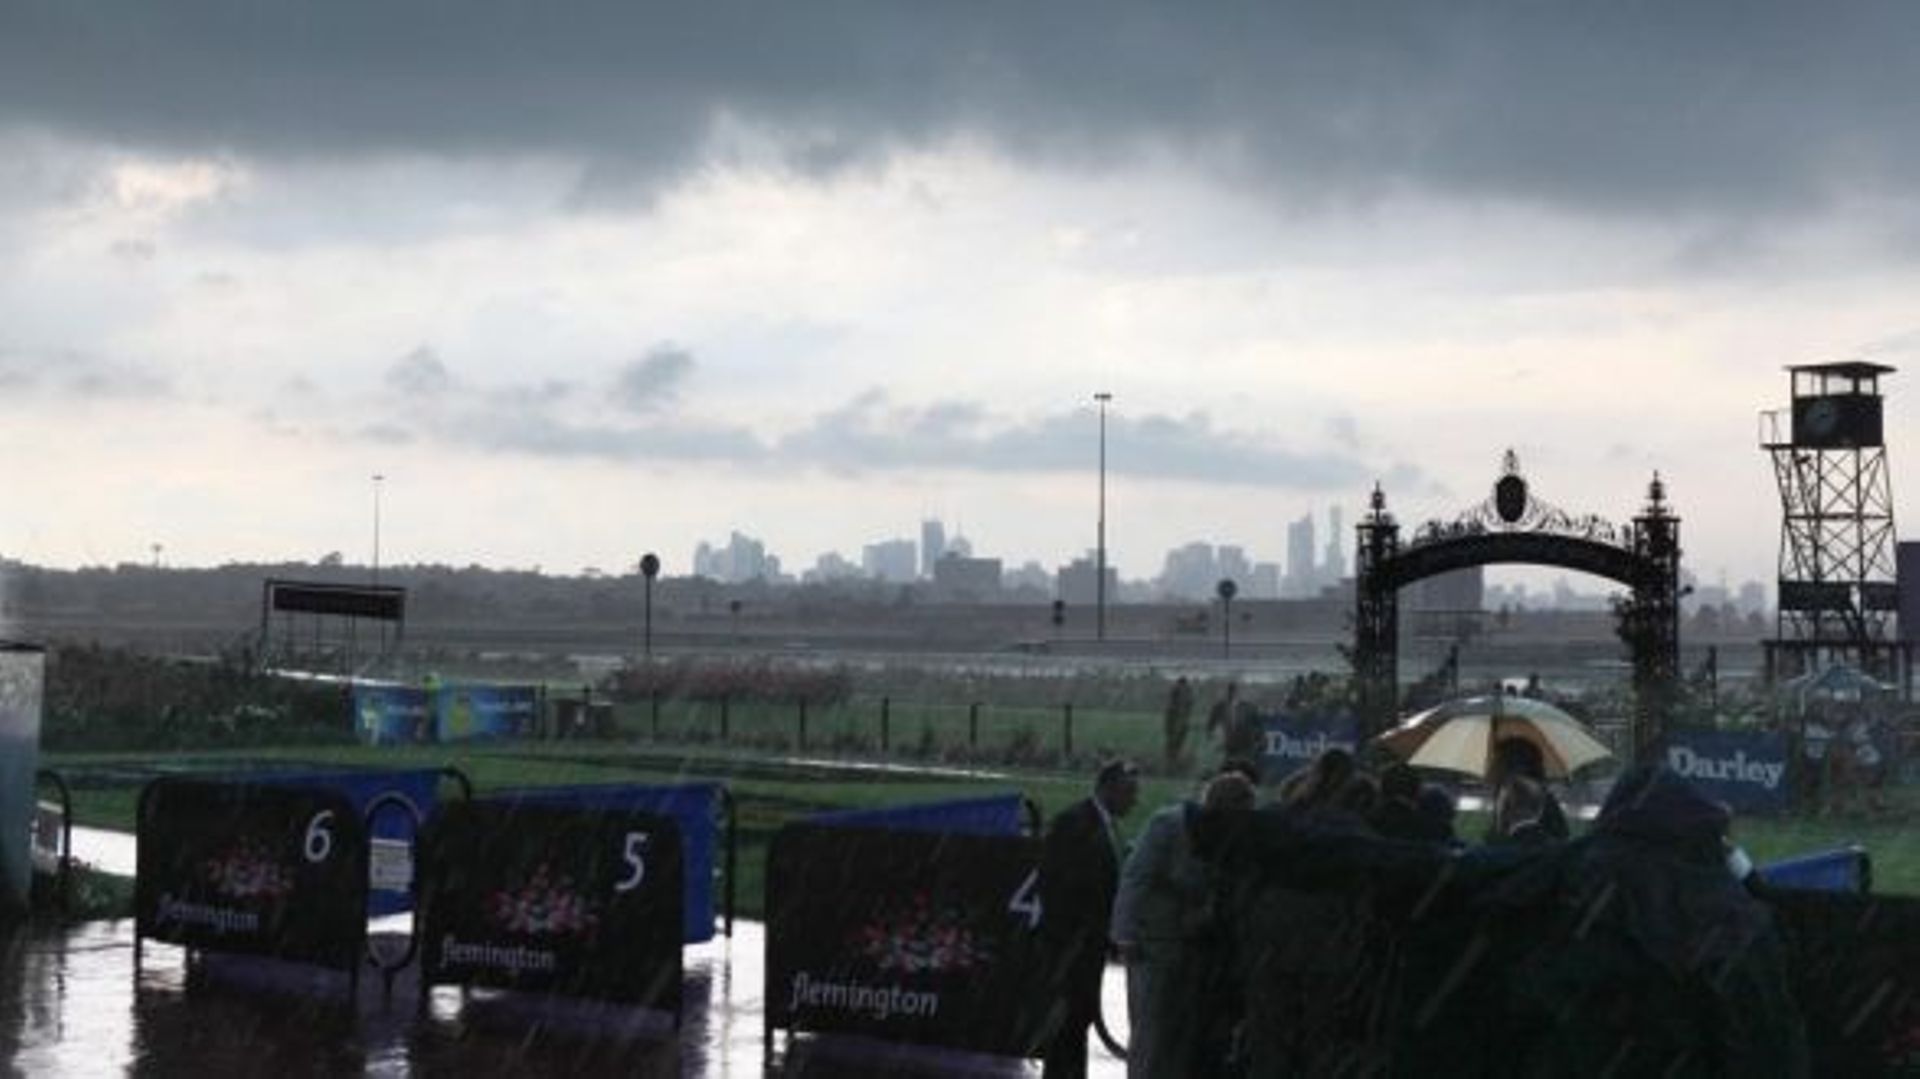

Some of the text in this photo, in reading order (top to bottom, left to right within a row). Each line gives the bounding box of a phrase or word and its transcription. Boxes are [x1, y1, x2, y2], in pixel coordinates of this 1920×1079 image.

[1667, 745, 1785, 789] Darley
[305, 810, 334, 863] 6
[615, 831, 649, 892] 5
[1008, 867, 1043, 928] 4
[439, 933, 555, 974] flemington
[788, 970, 939, 1020] flemington
